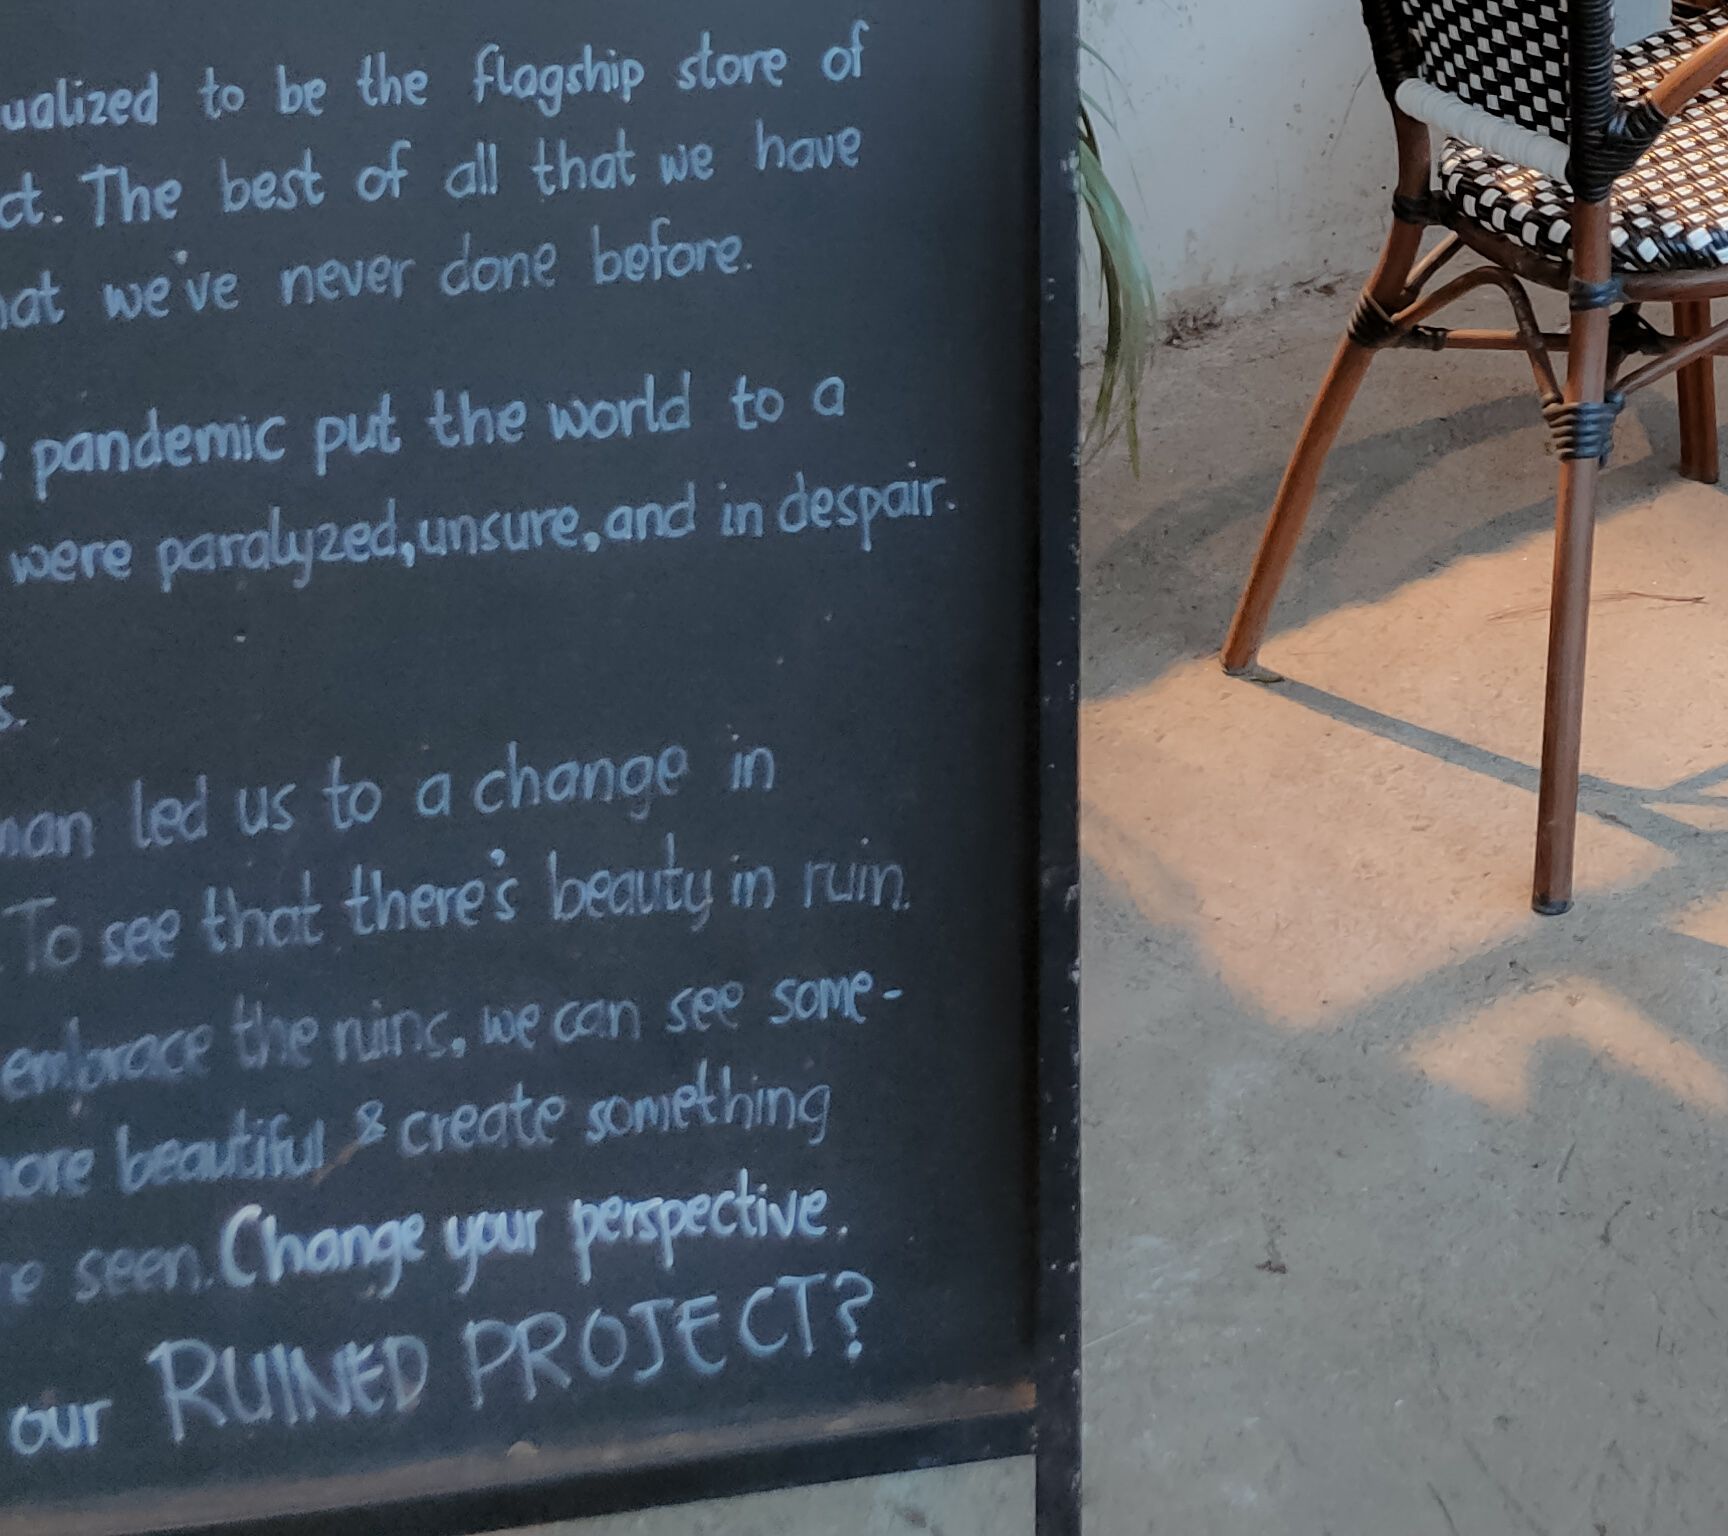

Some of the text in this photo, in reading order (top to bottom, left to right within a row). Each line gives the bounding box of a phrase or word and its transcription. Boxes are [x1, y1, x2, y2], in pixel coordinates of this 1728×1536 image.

[200, 66, 244, 120] to
[277, 64, 327, 115] be
[356, 51, 429, 107] the
[473, 43, 645, 118] flagship
[678, 30, 788, 89] store
[821, 19, 870, 82] of
[78, 163, 183, 227] The
[219, 147, 325, 213] best
[357, 139, 411, 203] of
[445, 141, 498, 199] all
[532, 128, 637, 196] that
[659, 143, 714, 186] we
[756, 118, 863, 173] have
[104, 249, 240, 321] we've
[281, 254, 416, 306] never
[440, 232, 557, 297] done
[591, 217, 753, 285] before.
[31, 407, 286, 502] pandemic
[315, 392, 402, 477] put
[428, 389, 528, 448] the
[548, 370, 692, 440] world
[730, 374, 785, 429] to
[813, 375, 846, 417] a
[9, 538, 133, 585] were
[718, 481, 764, 536] in
[777, 461, 958, 552] despair.
[130, 774, 208, 848] led
[235, 783, 297, 835] us
[322, 755, 382, 831] to
[416, 772, 452, 817] a
[474, 740, 688, 820] change
[730, 733, 775, 791] in
[2, 831, 910, 973] To see that there's beauty in ruin.
[234, 994, 320, 1070] the
[484, 1001, 540, 1049] we
[553, 996, 641, 1044] can
[666, 979, 745, 1033] see
[770, 970, 903, 1025] some-
[117, 1109, 325, 1194] beautiful
[401, 1080, 567, 1156] create
[585, 1057, 831, 1144] something
[219, 1203, 426, 1300] Change
[443, 1208, 544, 1295] your
[572, 1167, 849, 1285] perspective.
[9, 1270, 874, 1455] our RUINED PROJECT?
